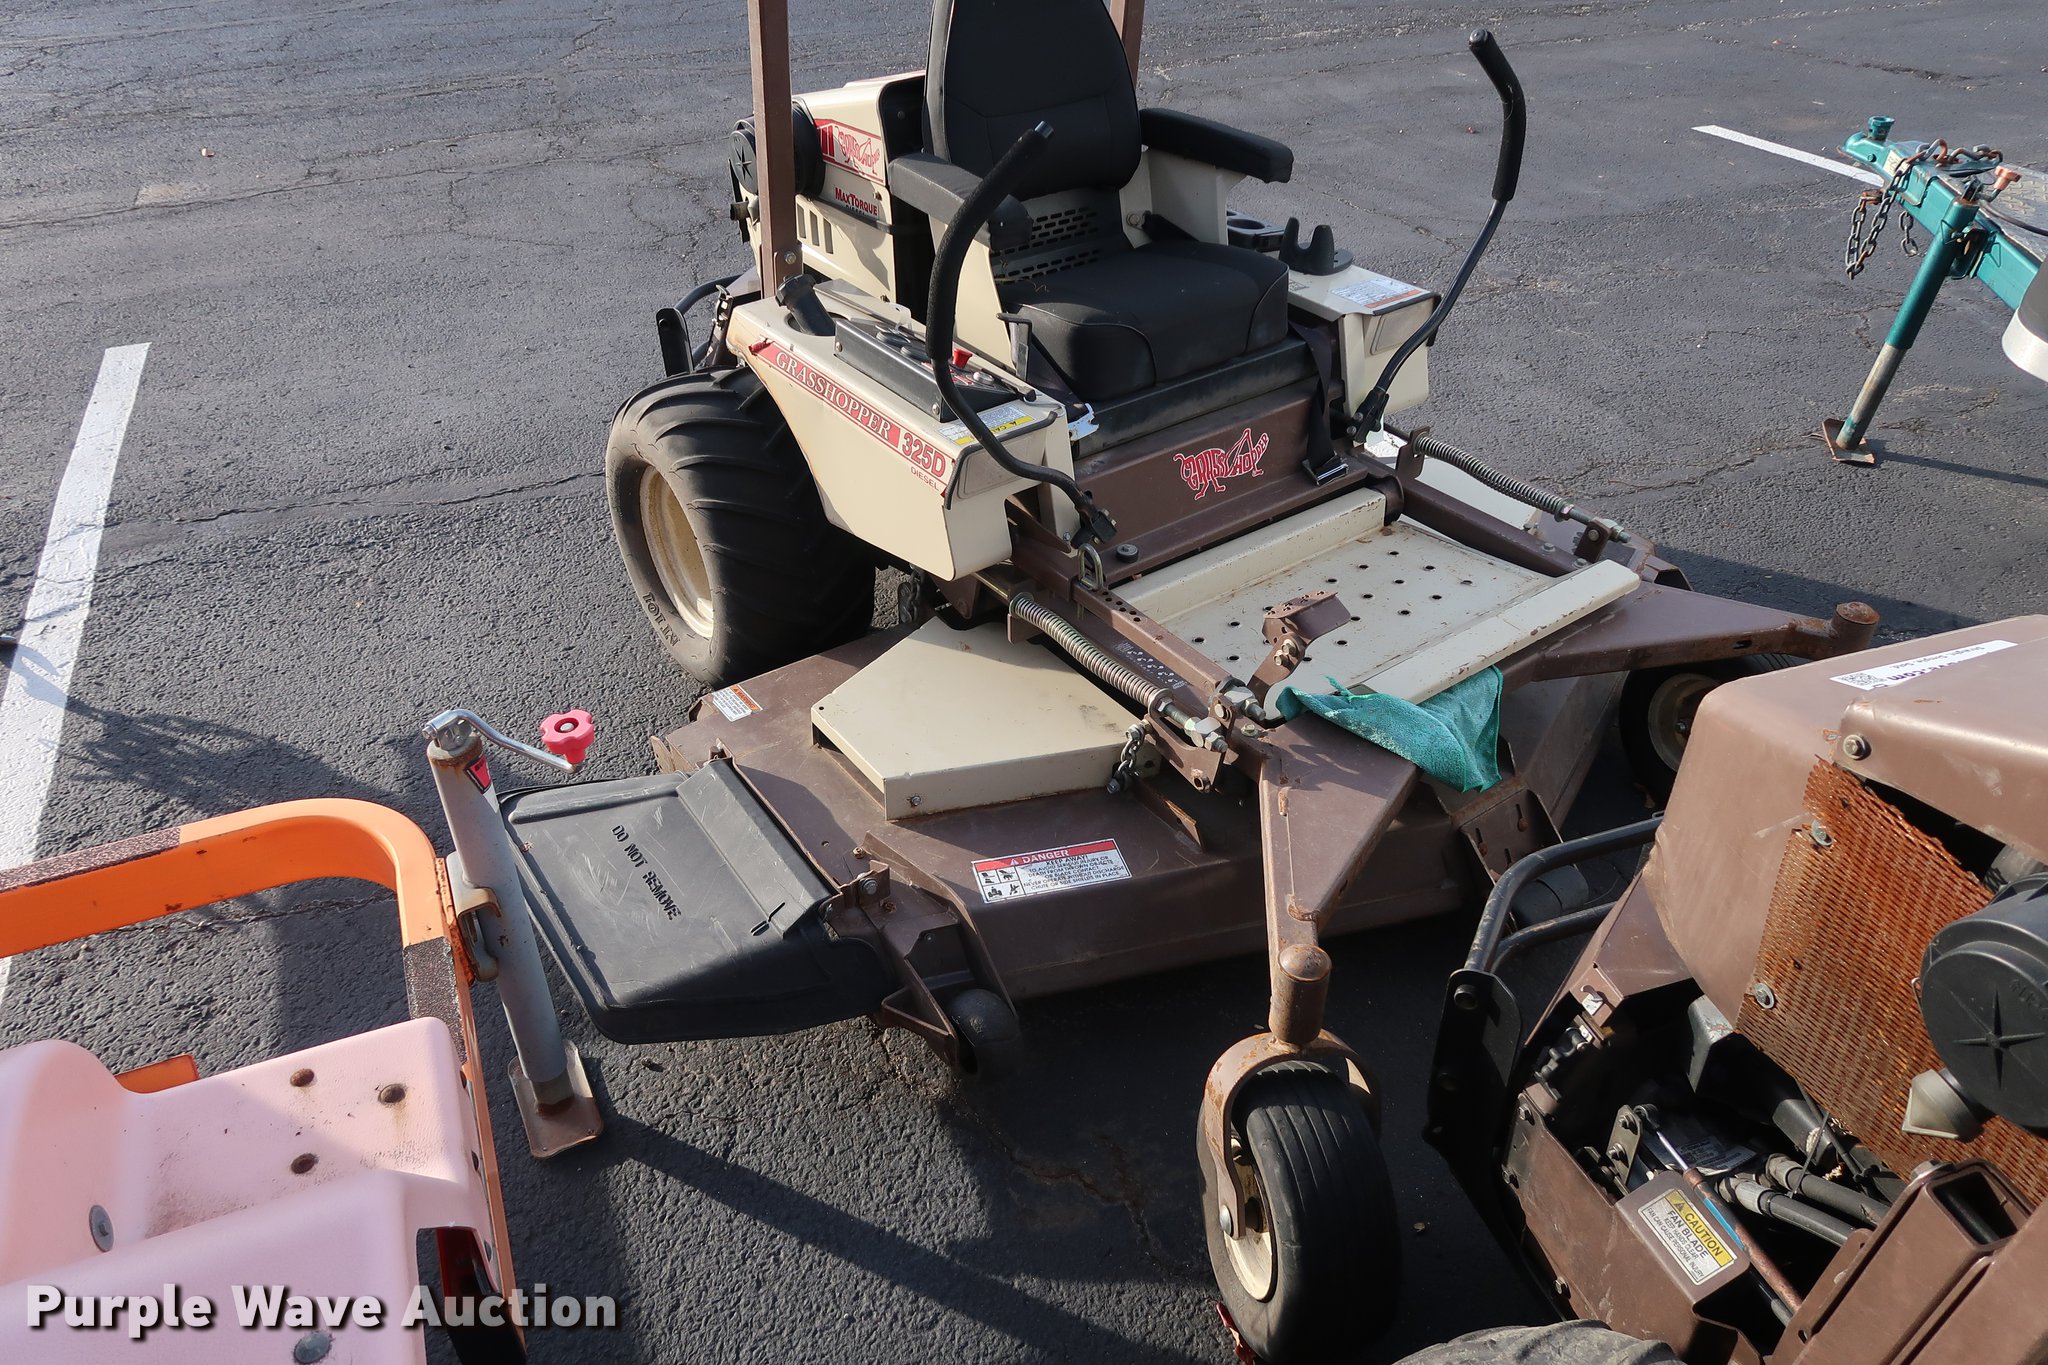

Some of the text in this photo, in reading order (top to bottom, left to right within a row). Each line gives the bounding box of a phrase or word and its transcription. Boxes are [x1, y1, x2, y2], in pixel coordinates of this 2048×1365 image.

[776, 351, 892, 440] GRASSHOPPER
[902, 432, 946, 478] 325D
[910, 466, 939, 491] DIESEL
[1173, 428, 1269, 500] GRASSHOPPER
[612, 824, 682, 920] DO NOT REMOVE
[1021, 850, 1070, 864] DANGER
[1046, 858, 1064, 866] KEEP
[1647, 1207, 1657, 1218] FAN
[1653, 1216, 1663, 1227] CAN
[1660, 1225, 1675, 1241] CAUSE
[1672, 1238, 1691, 1263] PERSONAL
[1689, 1261, 1705, 1277] INJURY
[1664, 1217, 1676, 1230] KEEP
[1673, 1228, 1688, 1245] HANDS
[1684, 1243, 1699, 1260] CLEAR
[1667, 1210, 1709, 1259] FAN BLADE
[1684, 1213, 1723, 1257] CAUTION
